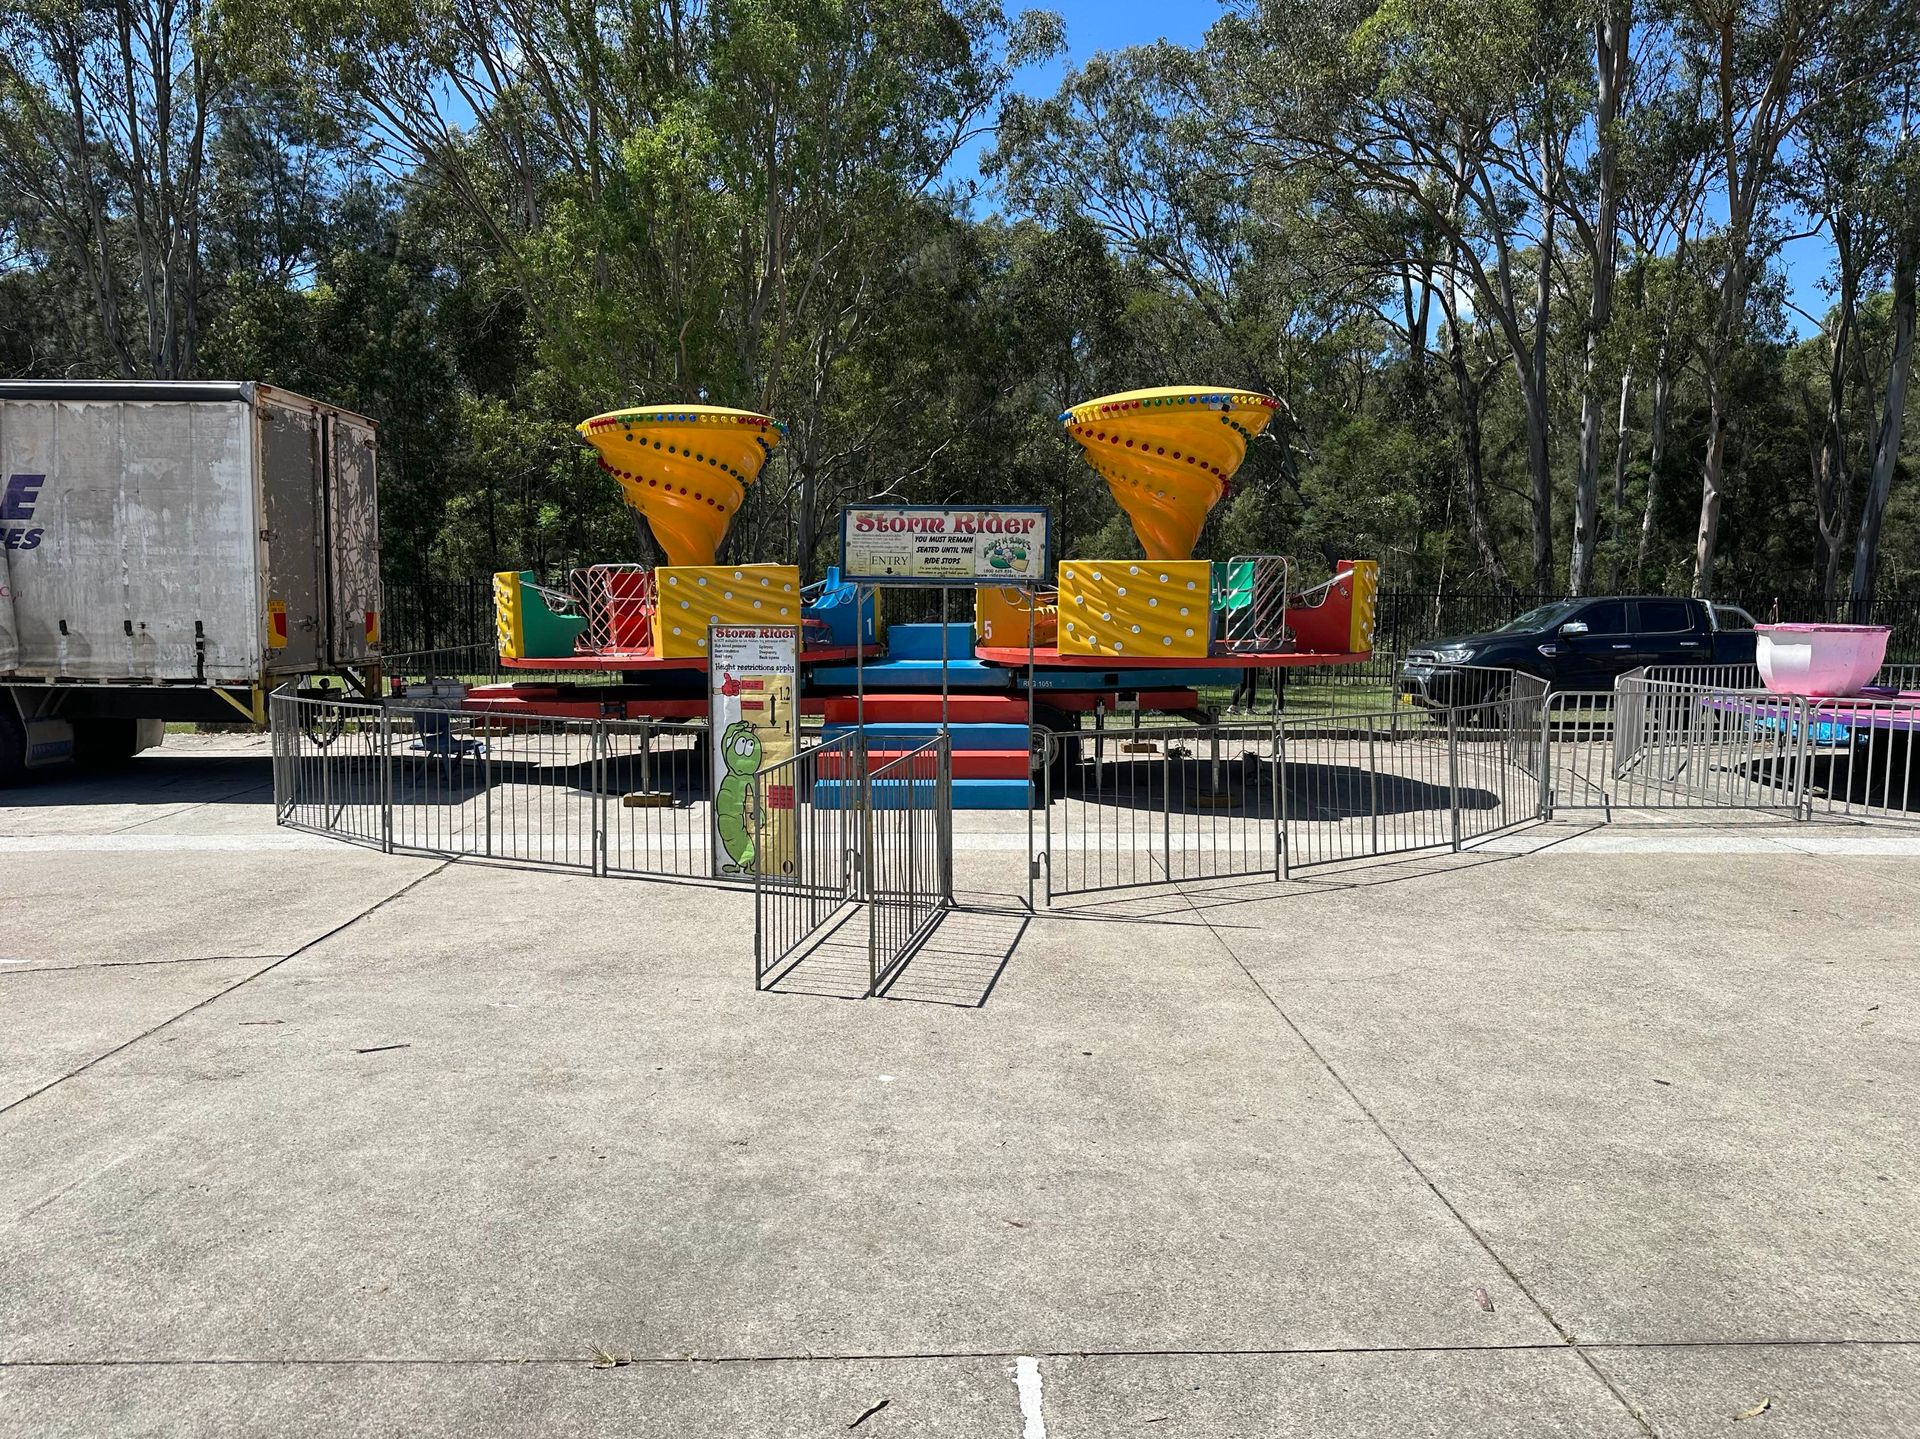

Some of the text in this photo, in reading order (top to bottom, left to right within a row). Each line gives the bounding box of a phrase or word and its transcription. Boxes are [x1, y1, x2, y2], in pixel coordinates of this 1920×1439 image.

[0, 474, 46, 520] E
[856, 512, 1035, 534] Storm Rider
[0, 528, 45, 550] ES
[871, 555, 909, 566] ENTRY
[715, 627, 795, 639] Storm Rider
[866, 617, 872, 636] 1
[984, 620, 992, 640] 5
[715, 663, 736, 672] Height
[775, 664, 795, 673] apply
[779, 686, 790, 701] 1.2
[785, 720, 790, 734] 1
